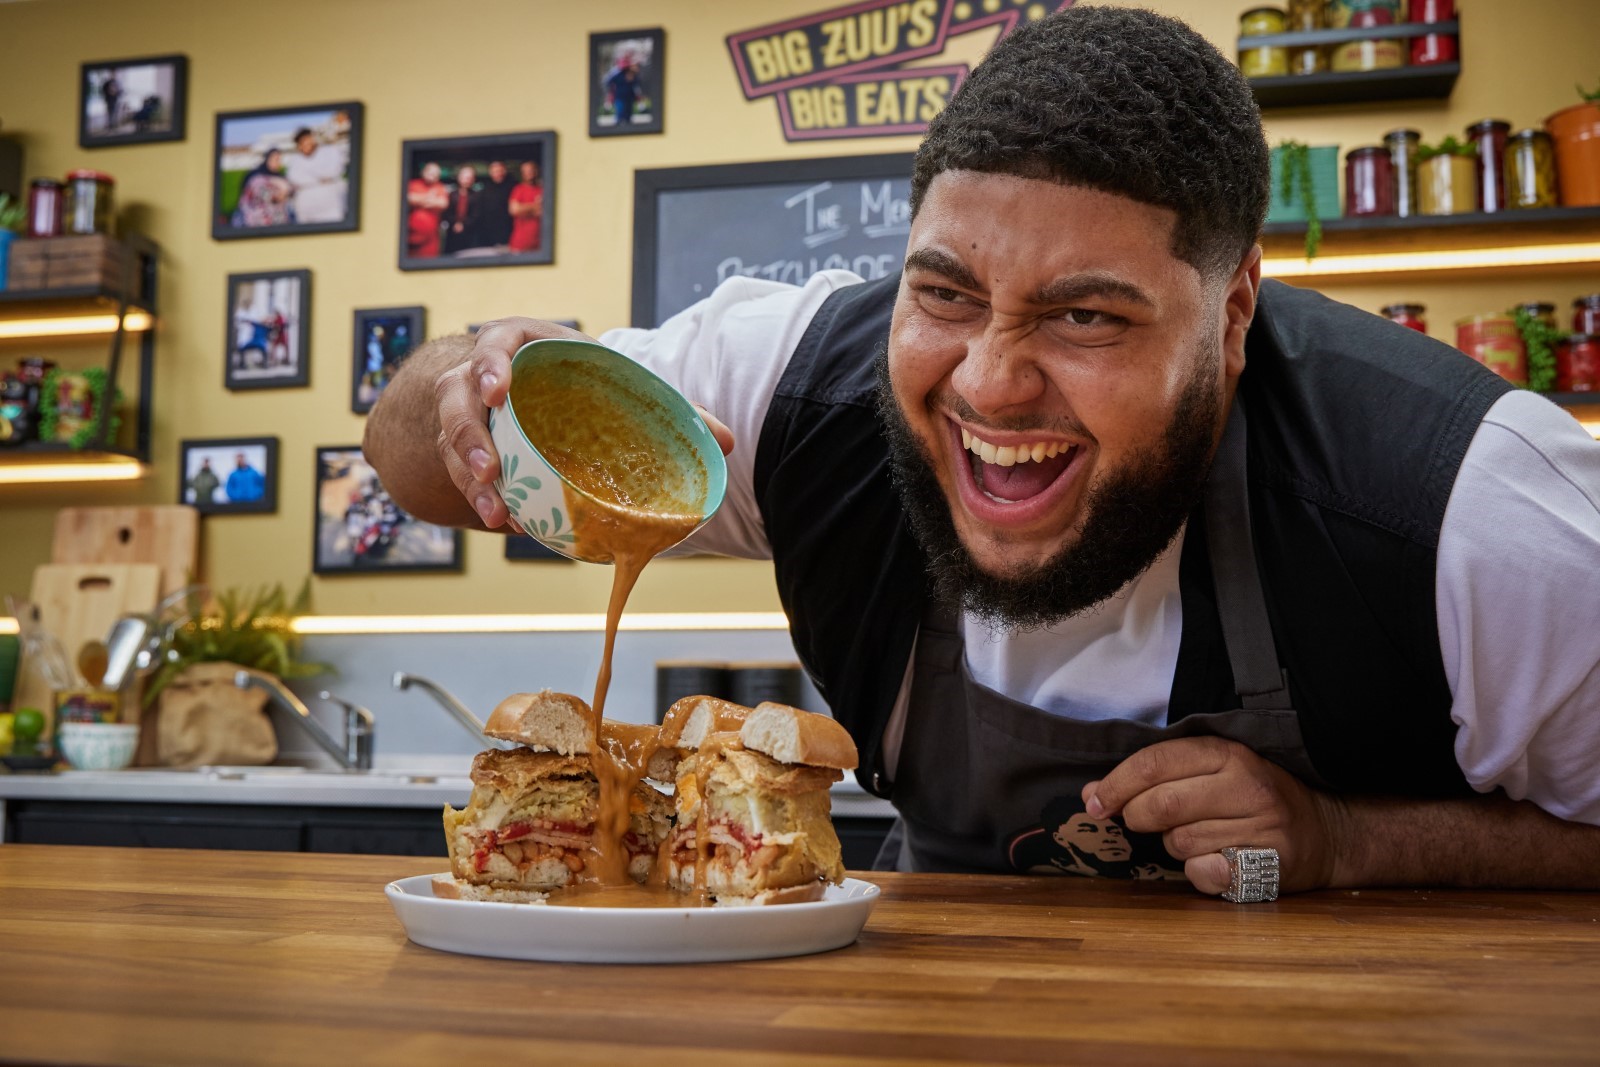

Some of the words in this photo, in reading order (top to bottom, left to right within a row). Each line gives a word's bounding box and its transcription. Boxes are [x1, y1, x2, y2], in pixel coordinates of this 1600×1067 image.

[746, 30, 813, 83] BIG
[820, 0, 939, 68] ZUU'S
[788, 87, 847, 130] BIG
[855, 76, 950, 127] EATS
